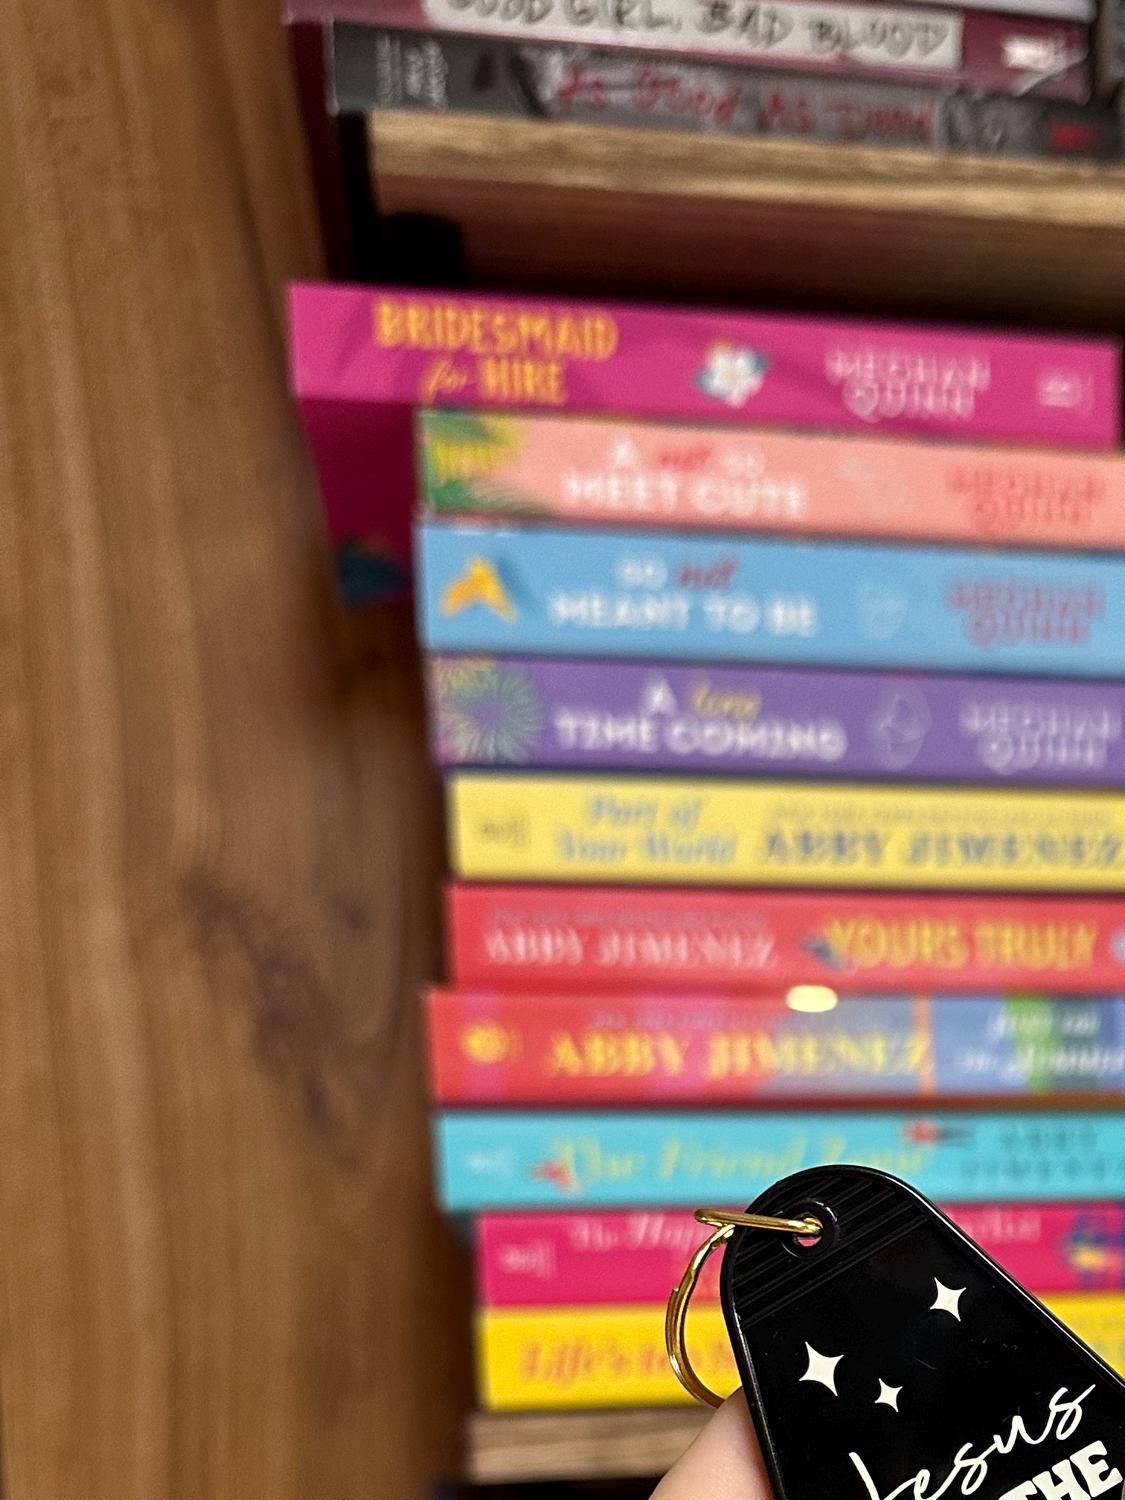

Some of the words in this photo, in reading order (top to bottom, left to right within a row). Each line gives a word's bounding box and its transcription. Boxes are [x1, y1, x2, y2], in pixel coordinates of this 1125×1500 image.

[372, 300, 619, 364] BRIDESMAID
[477, 354, 567, 405] HIRE
[560, 470, 680, 513] MEET
[548, 594, 691, 634] MEANT
[704, 602, 759, 636] TO
[552, 712, 660, 756] TIME
[760, 828, 889, 872] ABBY
[484, 924, 584, 968] ABBY
[597, 930, 779, 970] JIMENEZ
[828, 916, 970, 972] YOURS
[974, 918, 1100, 972] TRULY
[544, 1028, 689, 1080] ABBY
[704, 1030, 934, 1080] JIMENEZ
